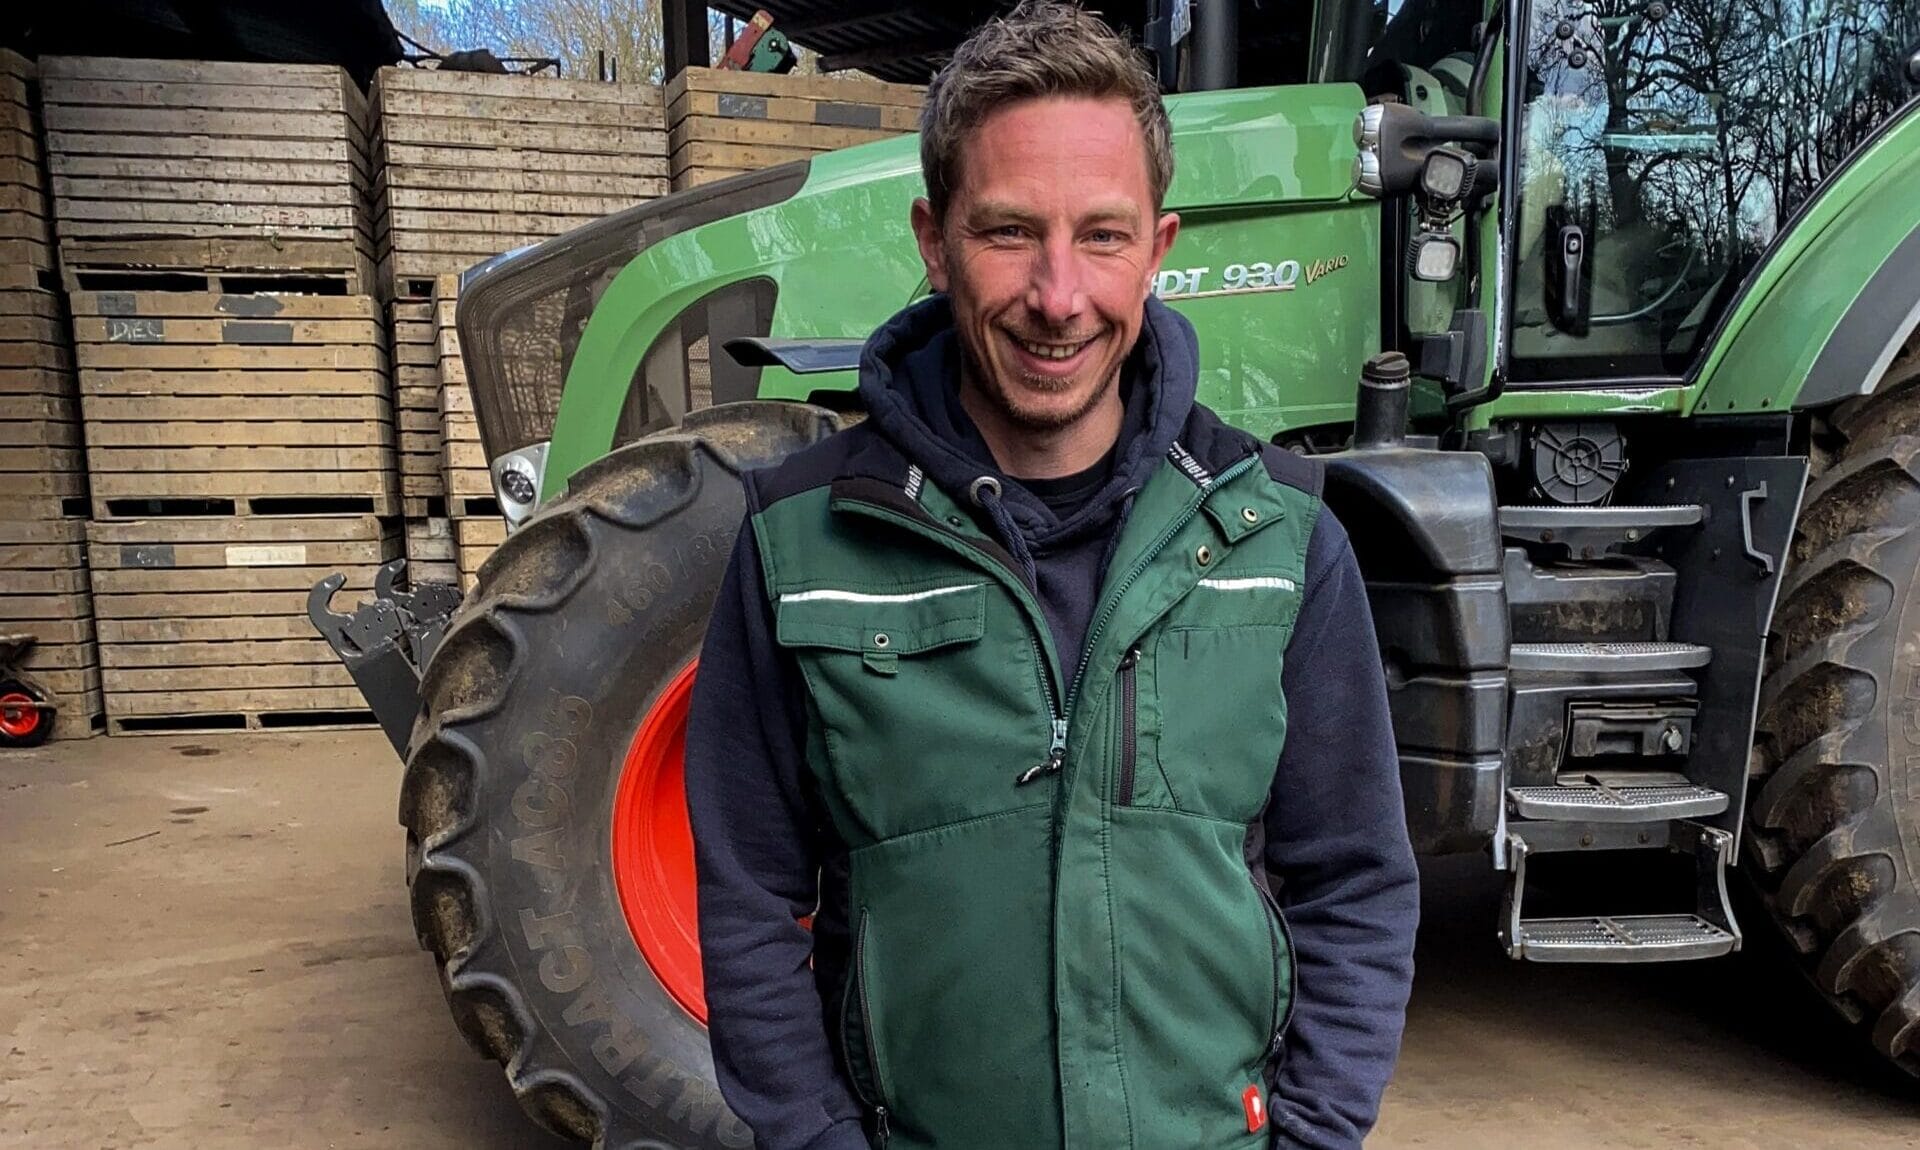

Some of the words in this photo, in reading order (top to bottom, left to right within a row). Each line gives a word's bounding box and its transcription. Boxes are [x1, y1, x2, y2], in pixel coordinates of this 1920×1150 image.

[1151, 267, 1209, 297] DT
[1223, 260, 1300, 290] 930
[1304, 254, 1349, 286] VARIO
[518, 908, 754, 1148] ONTRACT
